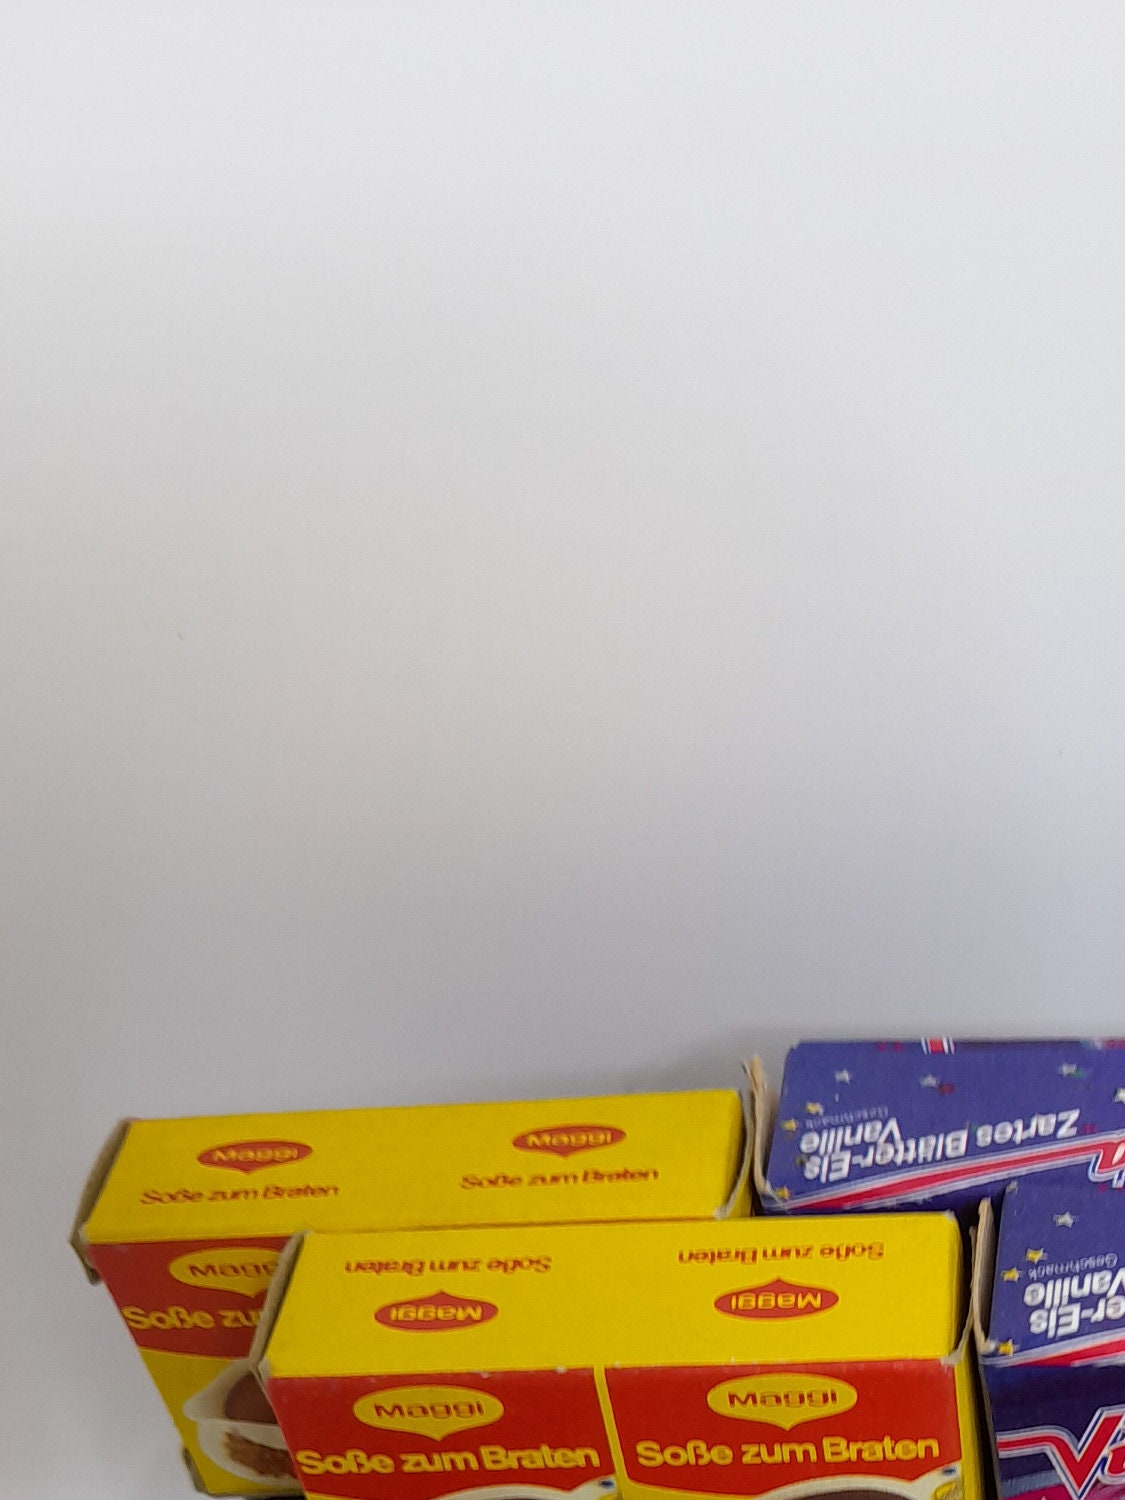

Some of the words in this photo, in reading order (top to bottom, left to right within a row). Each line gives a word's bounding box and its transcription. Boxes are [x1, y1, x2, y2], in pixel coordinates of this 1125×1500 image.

[800, 1117, 901, 1155] Vanille
[975, 1108, 1080, 1148] Zartes
[527, 1131, 612, 1148] Maggi
[213, 1149, 298, 1163] Maggi
[803, 1129, 969, 1184] Blätter-Eis
[460, 1173, 523, 1190] Soße
[528, 1172, 578, 1187] zum
[582, 1168, 659, 1183] Braten
[140, 1188, 204, 1205] Soße
[208, 1188, 258, 1202] zum
[262, 1183, 340, 1200] Braten
[678, 1243, 757, 1266] Braten
[762, 1244, 814, 1262] zum
[819, 1241, 885, 1261] Soße
[189, 1261, 279, 1279] Magg
[345, 1256, 426, 1277] Braten
[429, 1258, 481, 1274] zum
[486, 1256, 553, 1275] Soße
[729, 1290, 823, 1311] Maggi
[121, 1304, 216, 1331] Soße
[219, 1307, 263, 1329] zu
[389, 1303, 483, 1322] Maggi
[374, 1399, 486, 1420] Maggi
[728, 1389, 838, 1409] Maggi
[296, 1448, 396, 1476] Soße
[401, 1450, 480, 1474] zum
[479, 1443, 601, 1472] Braten
[635, 1438, 733, 1467] Soße
[742, 1439, 816, 1465] zum
[822, 1435, 940, 1464] Braten
